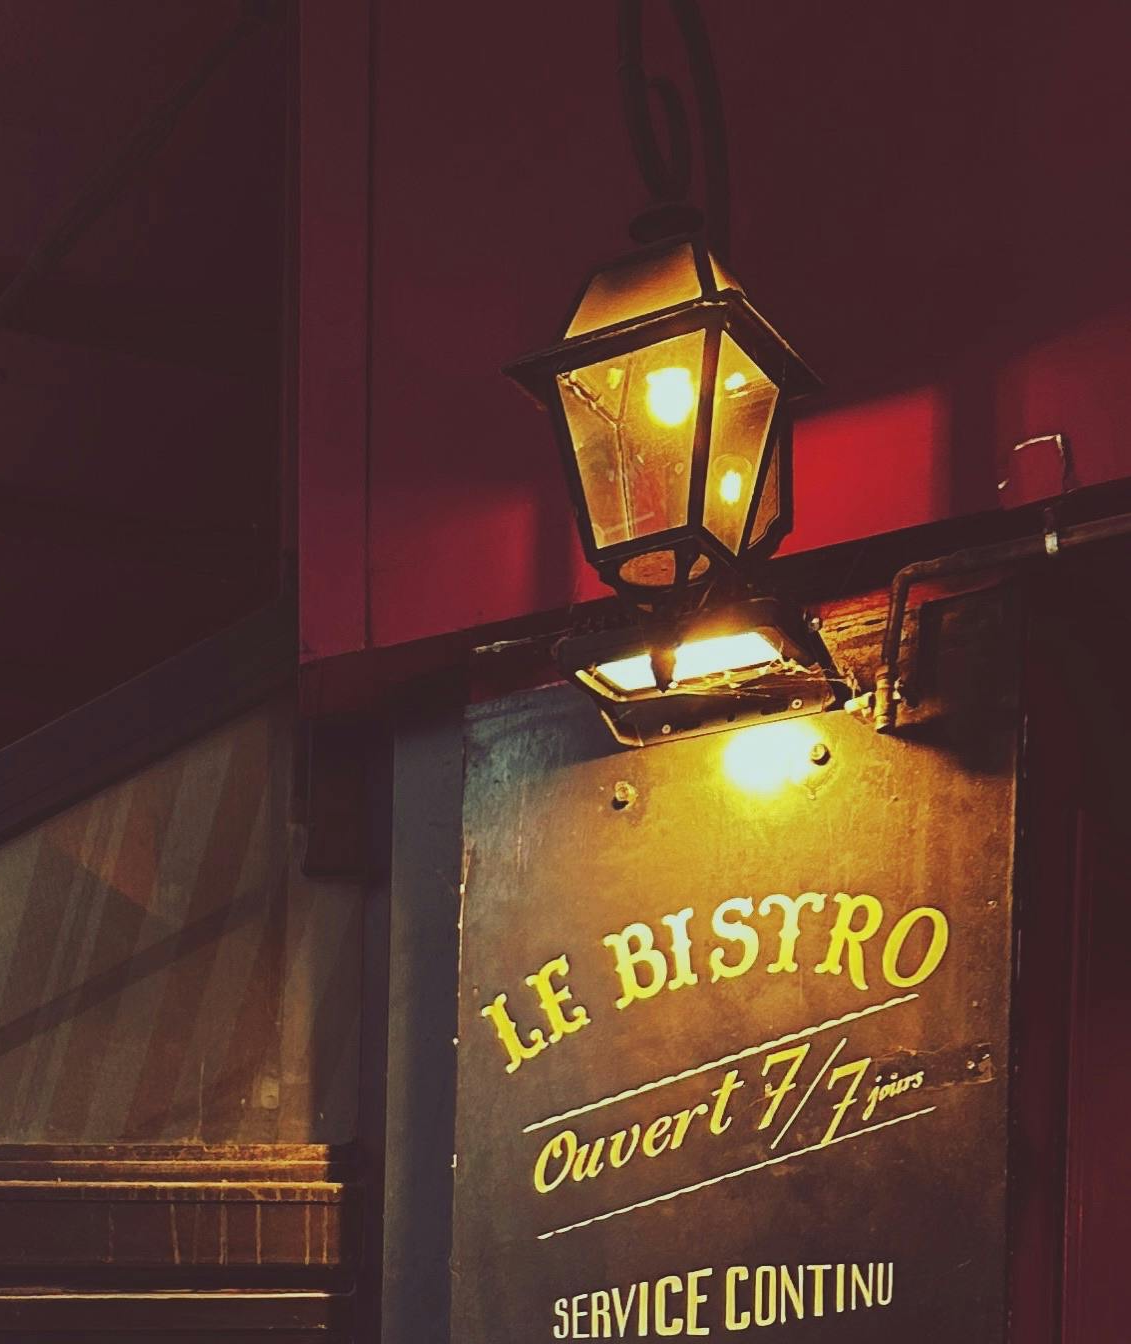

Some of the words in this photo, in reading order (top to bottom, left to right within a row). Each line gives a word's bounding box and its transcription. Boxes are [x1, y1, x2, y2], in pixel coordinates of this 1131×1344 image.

[481, 955, 591, 1073] LE
[603, 893, 949, 1009] BISTRO
[533, 1069, 750, 1195] Ouvert
[758, 1037, 872, 1149] 7/7
[862, 1069, 925, 1121] jours
[552, 1267, 713, 1339] SERVICE
[725, 1262, 894, 1332] CONTINU
